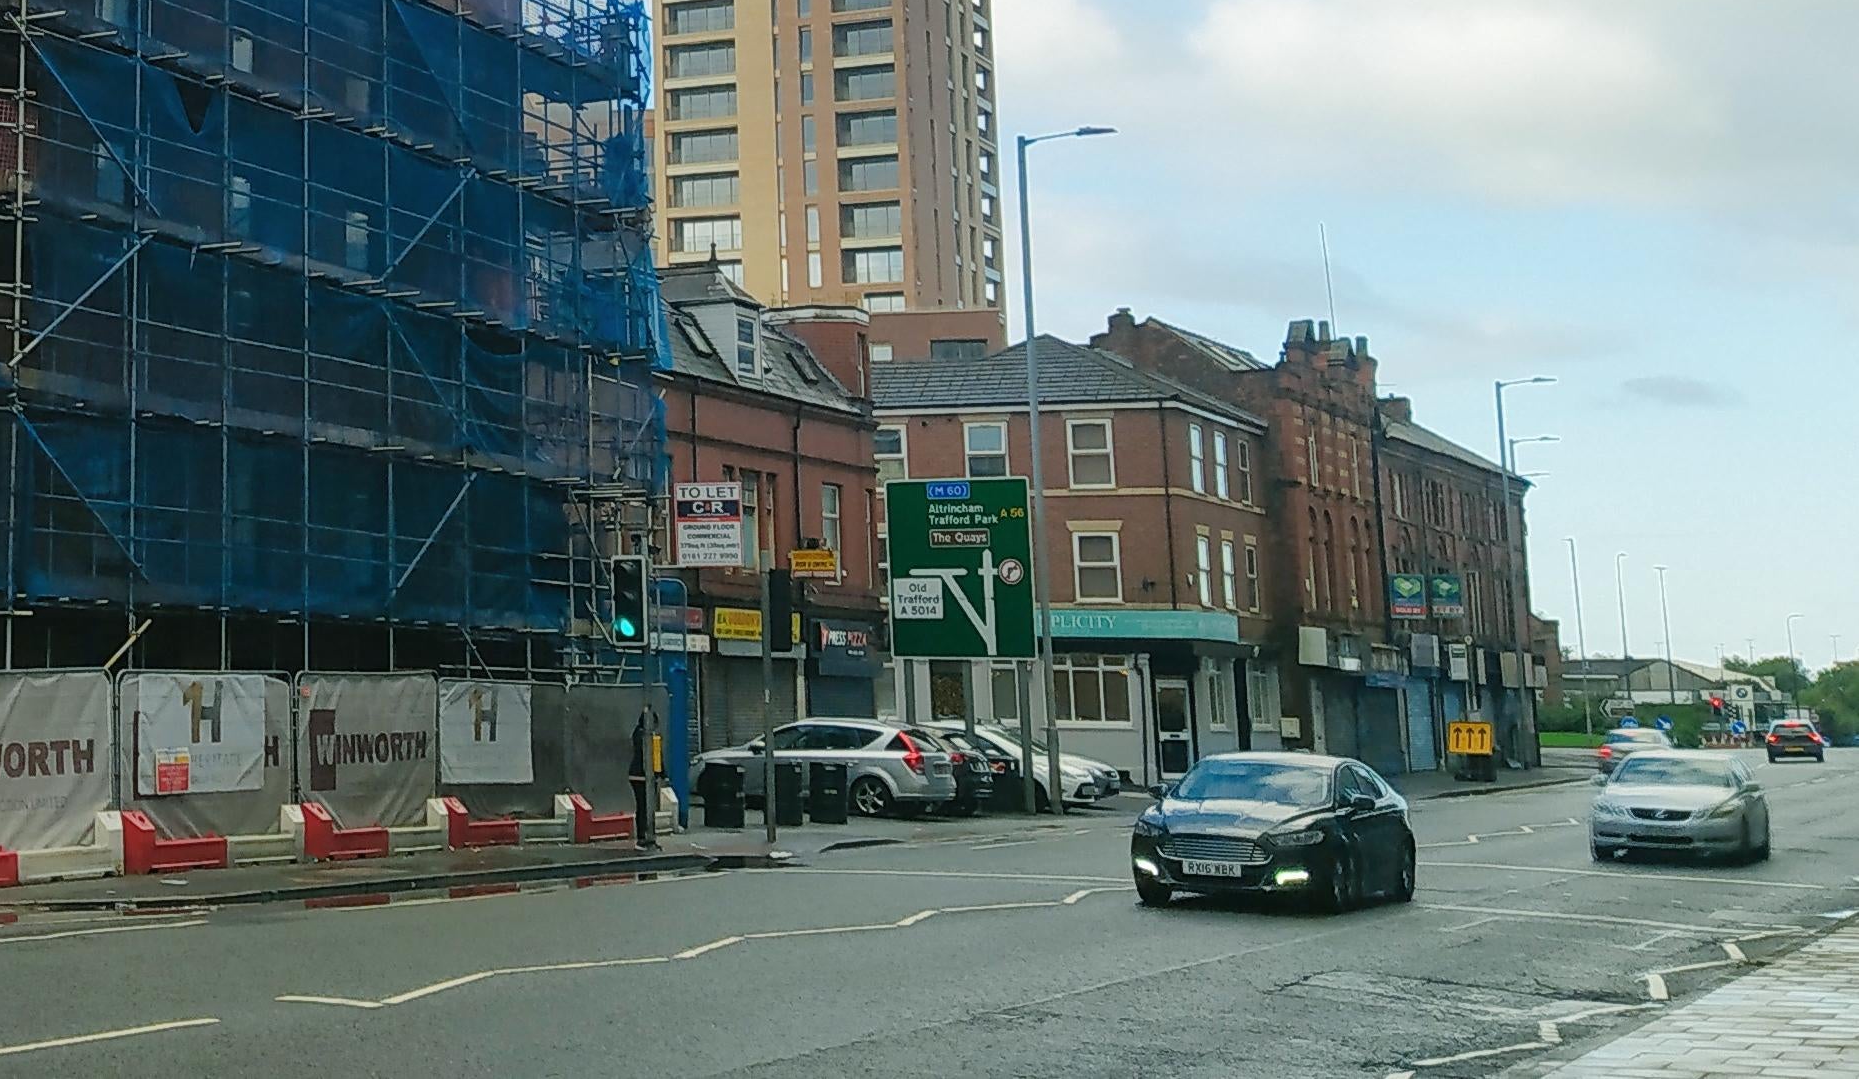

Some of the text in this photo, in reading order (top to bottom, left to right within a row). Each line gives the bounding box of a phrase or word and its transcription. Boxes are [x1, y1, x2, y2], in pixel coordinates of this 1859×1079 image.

[679, 486, 737, 499] TO LET
[947, 486, 968, 496] 60)
[929, 503, 984, 514] Altrincham
[1000, 508, 1025, 518] A 56
[929, 514, 999, 525] Trafford Park
[933, 532, 988, 545] The Quays
[908, 583, 927, 593] Old
[897, 594, 940, 604] Trafford
[900, 606, 937, 615] A 5014
[316, 730, 428, 766] WINWORTH
